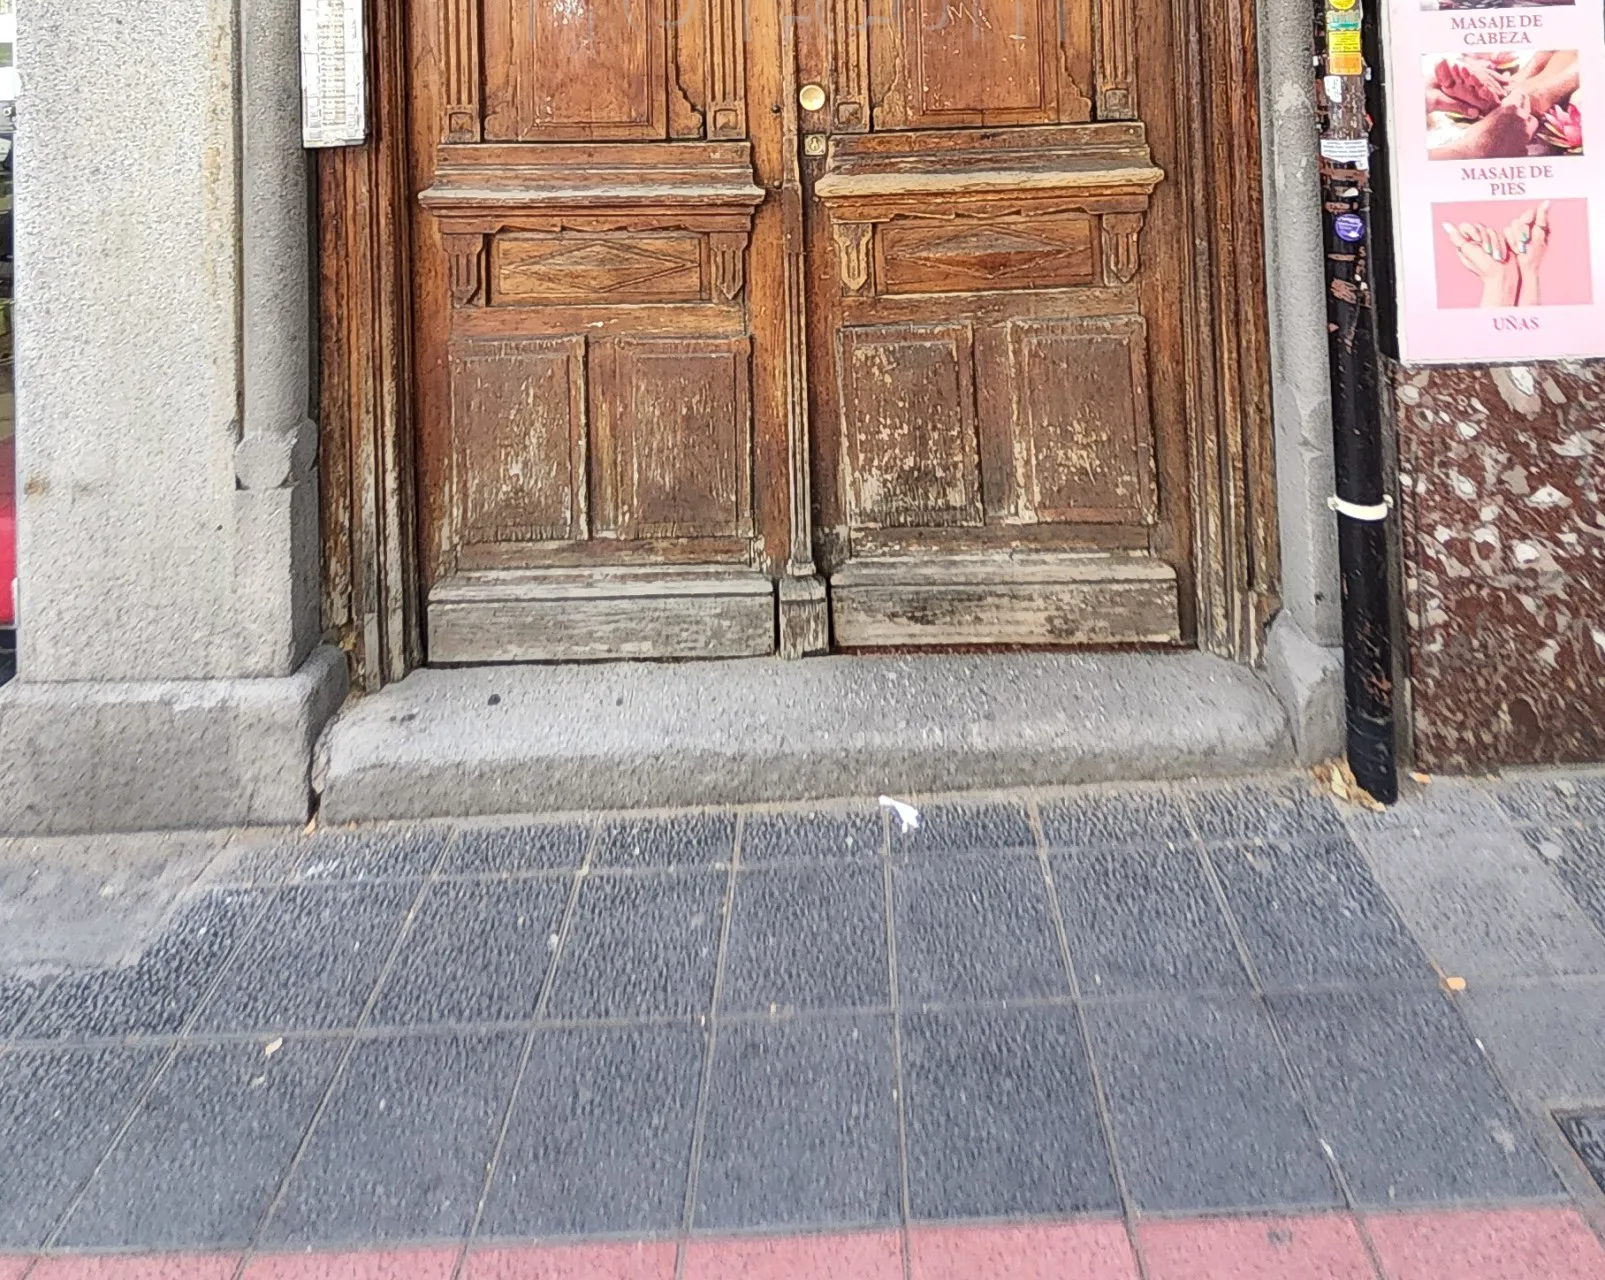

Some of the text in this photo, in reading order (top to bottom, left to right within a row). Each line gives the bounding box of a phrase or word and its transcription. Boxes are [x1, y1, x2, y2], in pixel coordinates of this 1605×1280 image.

[1451, 15, 1543, 30] MASAJE DE
[1464, 31, 1532, 45] CABEZA
[1461, 165, 1554, 181] MASAJE DE
[1490, 182, 1526, 196] PIES
[1492, 315, 1540, 331] UÑAS
